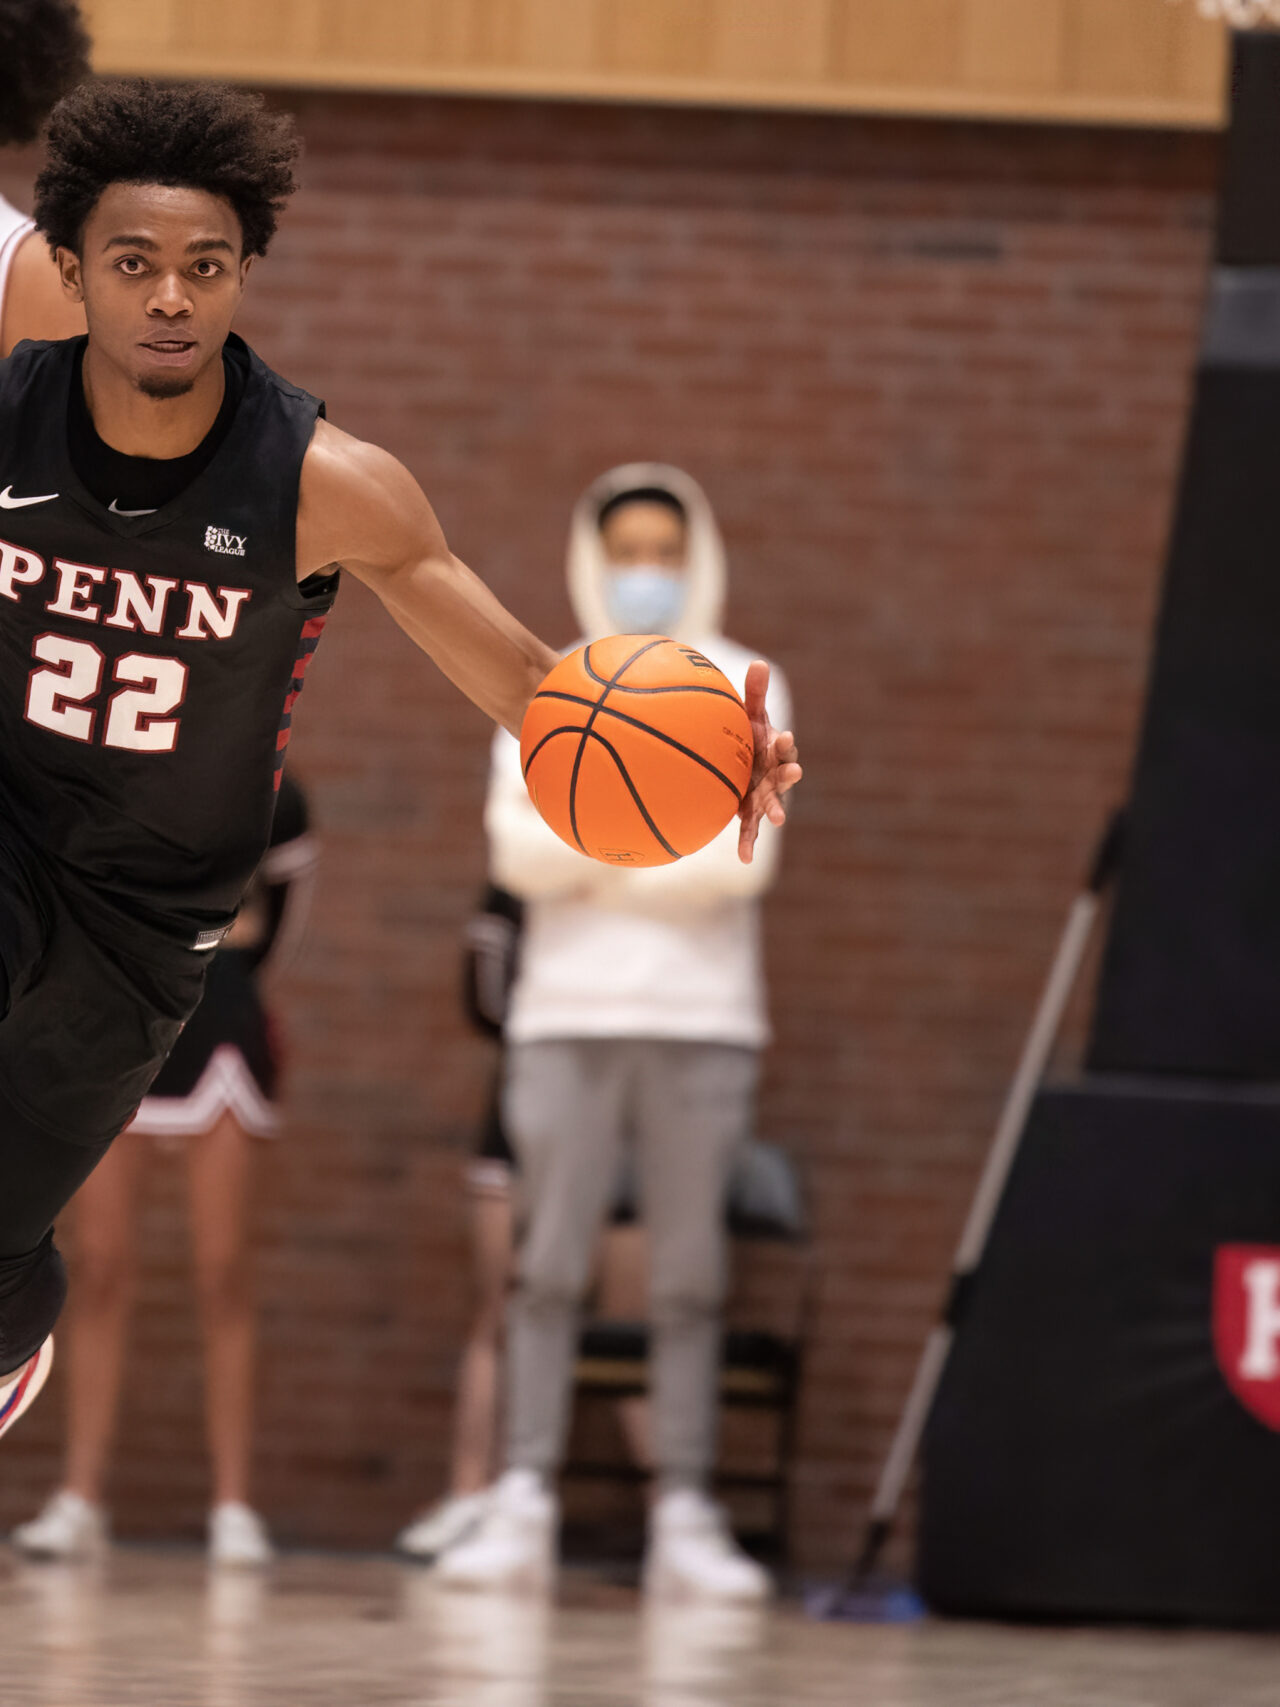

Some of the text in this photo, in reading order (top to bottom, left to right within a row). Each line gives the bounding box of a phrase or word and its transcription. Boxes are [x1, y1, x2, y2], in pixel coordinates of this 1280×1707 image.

[215, 533, 248, 549] IVY
[214, 545, 246, 557] LEAGUE
[23, 631, 190, 754] 22
